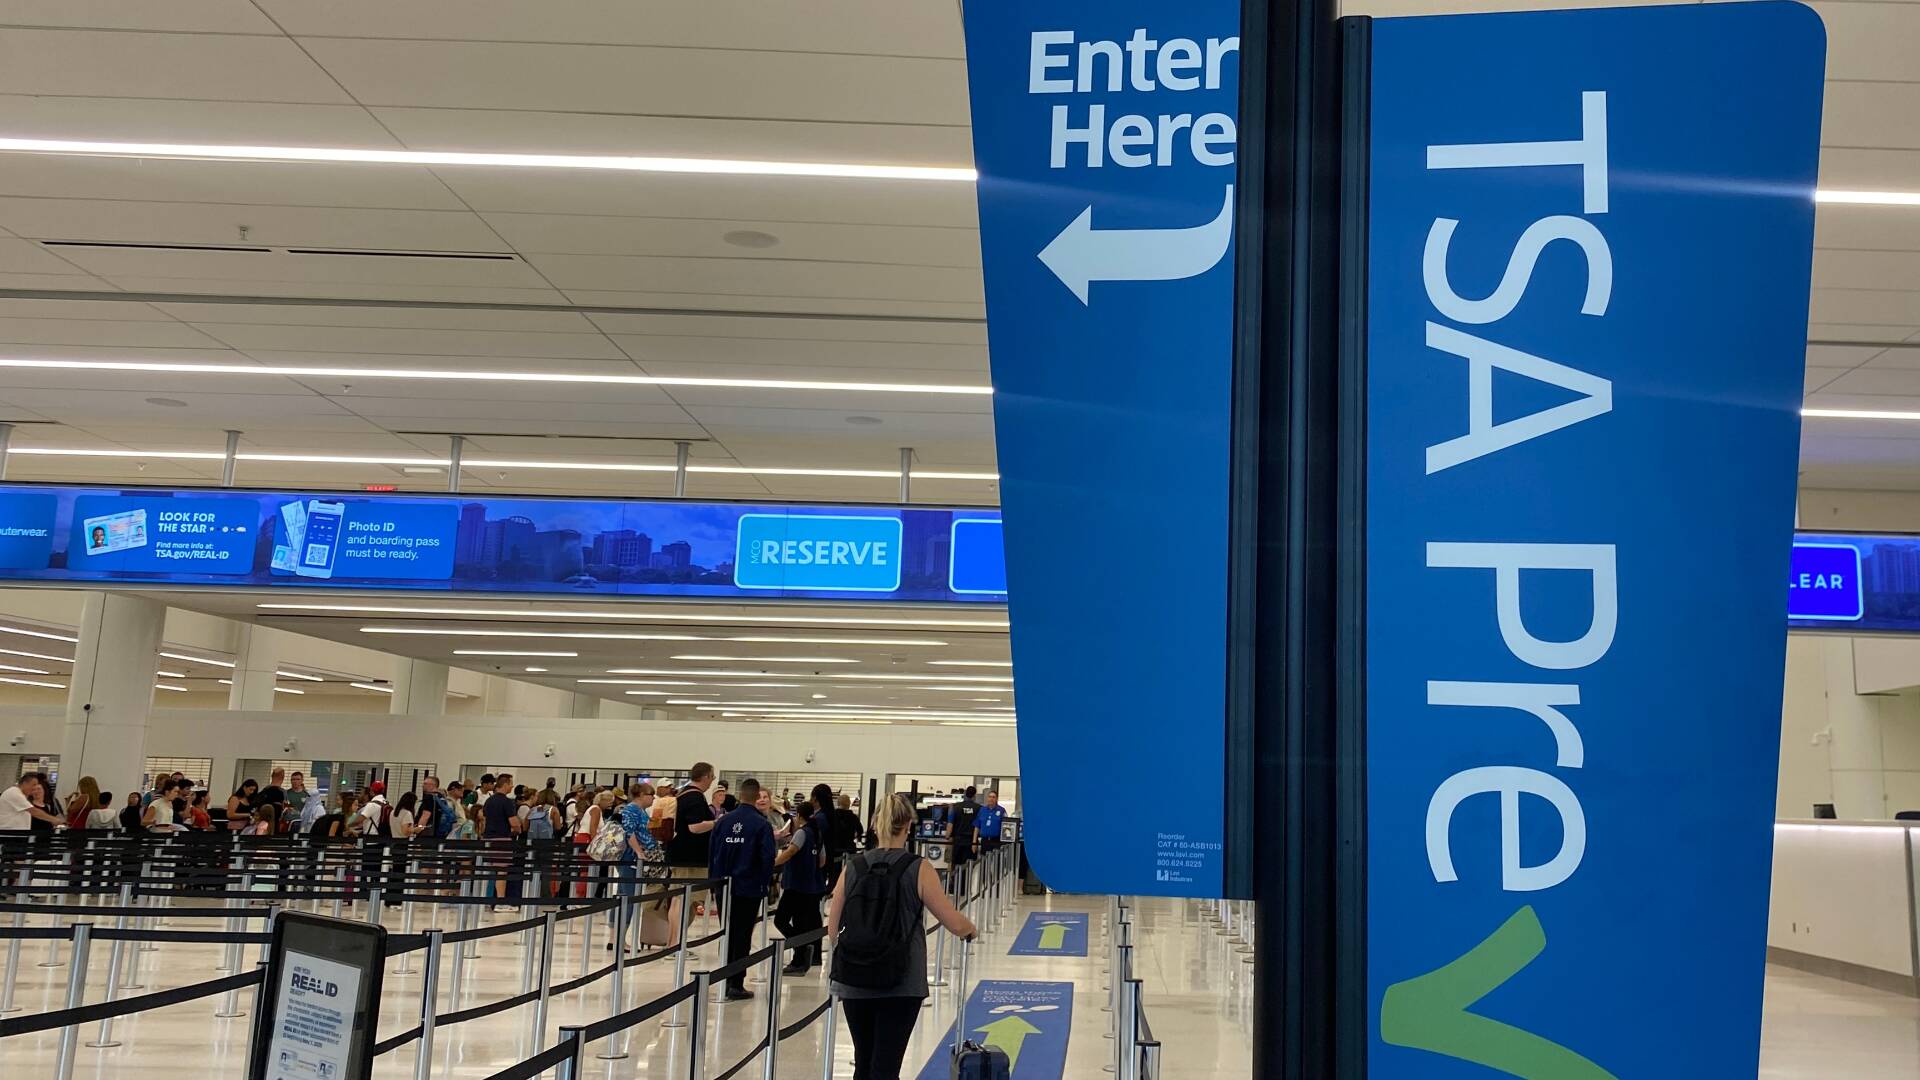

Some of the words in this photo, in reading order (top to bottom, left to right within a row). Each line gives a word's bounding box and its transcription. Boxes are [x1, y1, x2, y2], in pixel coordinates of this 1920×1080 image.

[1028, 28, 1240, 93] Enter
[1050, 104, 1237, 168] Here
[1422, 90, 1613, 475] TSA
[159, 512, 190, 522] LOOK
[193, 512, 216, 523] FOR
[348, 521, 381, 532] Photo
[382, 522, 395, 532] ID
[158, 522, 178, 533] THE
[179, 523, 207, 533] STAR
[156, 541, 171, 549] Find
[346, 535, 367, 545] and
[368, 535, 413, 548] boarding
[415, 537, 440, 547] pass
[155, 549, 229, 560] TSA.gov/REAL-ID
[346, 548, 371, 558] must
[373, 548, 387, 558] be
[388, 549, 419, 561] ready.
[751, 539, 761, 564] MCO
[761, 540, 887, 566] RESERVE
[1425, 541, 1618, 891] Pre
[291, 973, 324, 994] REAL
[324, 982, 338, 997] ID
